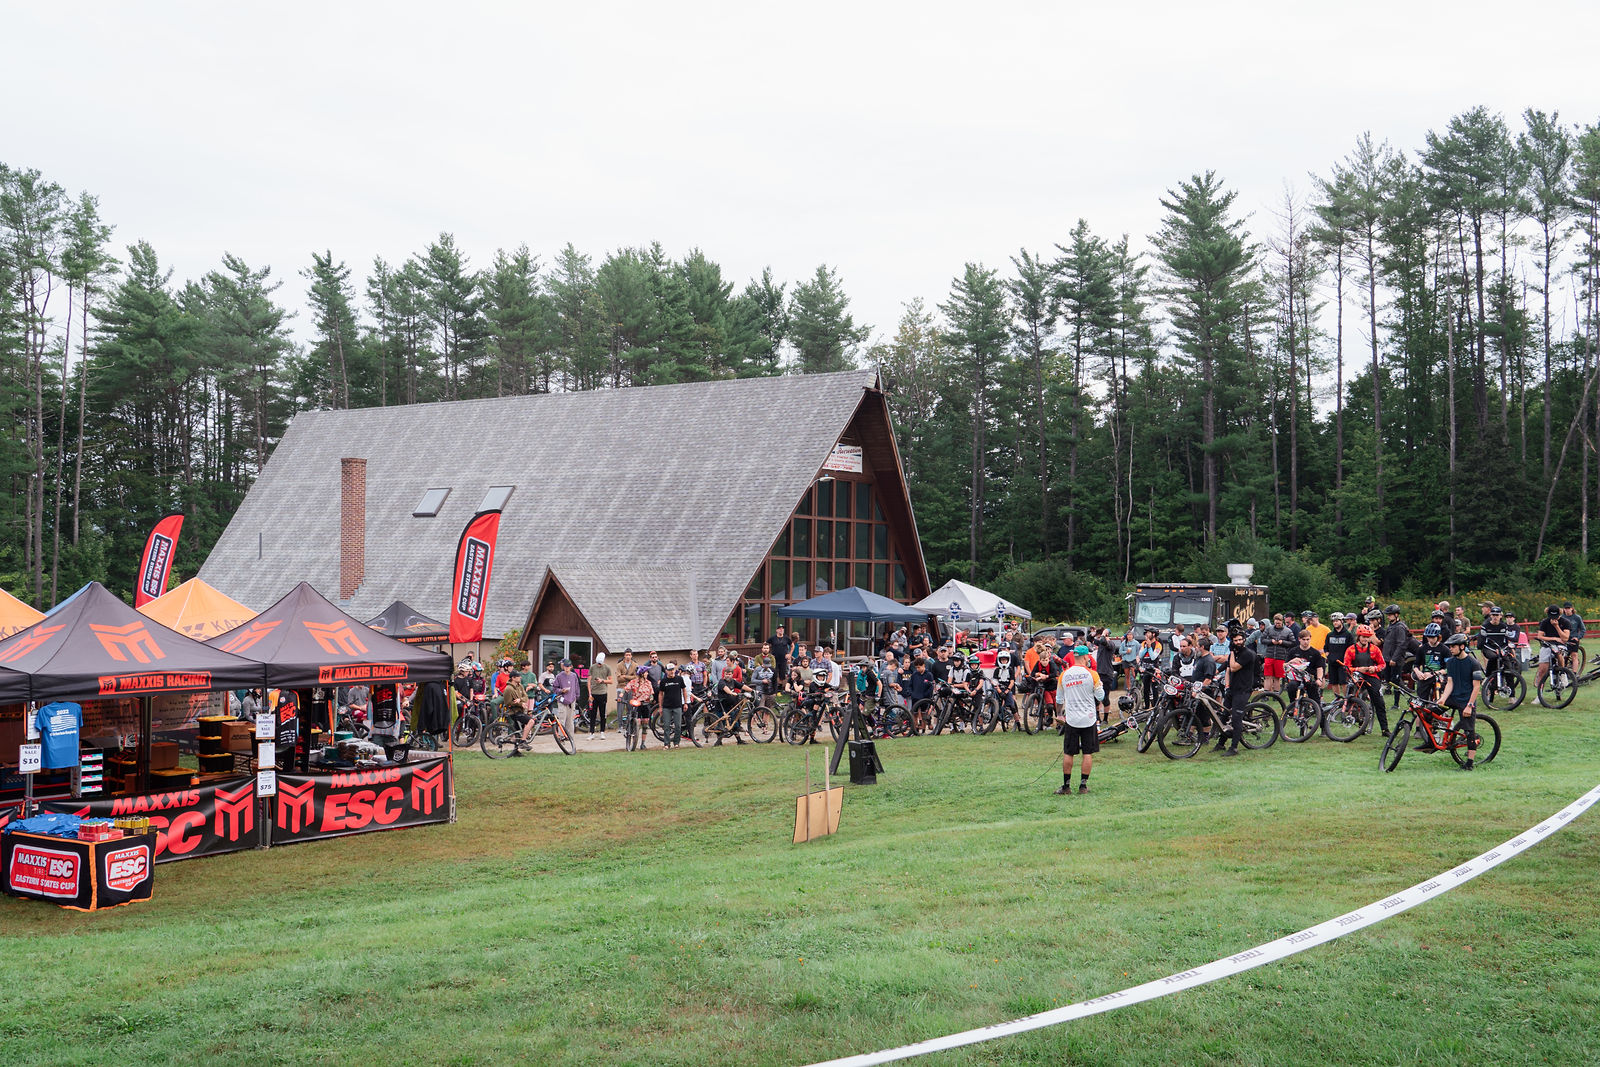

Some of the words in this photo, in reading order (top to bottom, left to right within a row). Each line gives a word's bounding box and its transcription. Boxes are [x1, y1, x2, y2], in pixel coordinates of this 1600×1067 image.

[153, 540, 168, 579] MAXXIS
[471, 545, 485, 595] MAXXIS
[150, 579, 159, 595] ESC
[468, 596, 478, 615] ESC
[1233, 598, 1255, 627] Epic
[210, 619, 248, 632] KAT
[334, 666, 371, 680] MAXXIS
[372, 664, 405, 678] RACING
[119, 674, 164, 690] MAXXIS
[166, 673, 208, 687] RACING
[331, 767, 402, 789] MAXXIS
[110, 789, 200, 816] MAXXIS
[320, 786, 404, 832] ESC
[149, 811, 206, 856] SC
[114, 850, 140, 860] MAXXIS
[1482, 852, 1501, 862] TREK
[17, 852, 48, 868] MAXXIS
[49, 858, 74, 879] ESC
[109, 856, 147, 880] ESC
[1452, 866, 1473, 878] TREK
[15, 873, 40, 887] EASTERN
[60, 882, 76, 891] CUP
[1418, 881, 1441, 893] TREK
[1380, 897, 1406, 909] TREK
[1336, 913, 1364, 927] TREK
[1286, 931, 1318, 945] TREK
[1228, 949, 1265, 964] TREK
[1162, 969, 1203, 985] TREK
